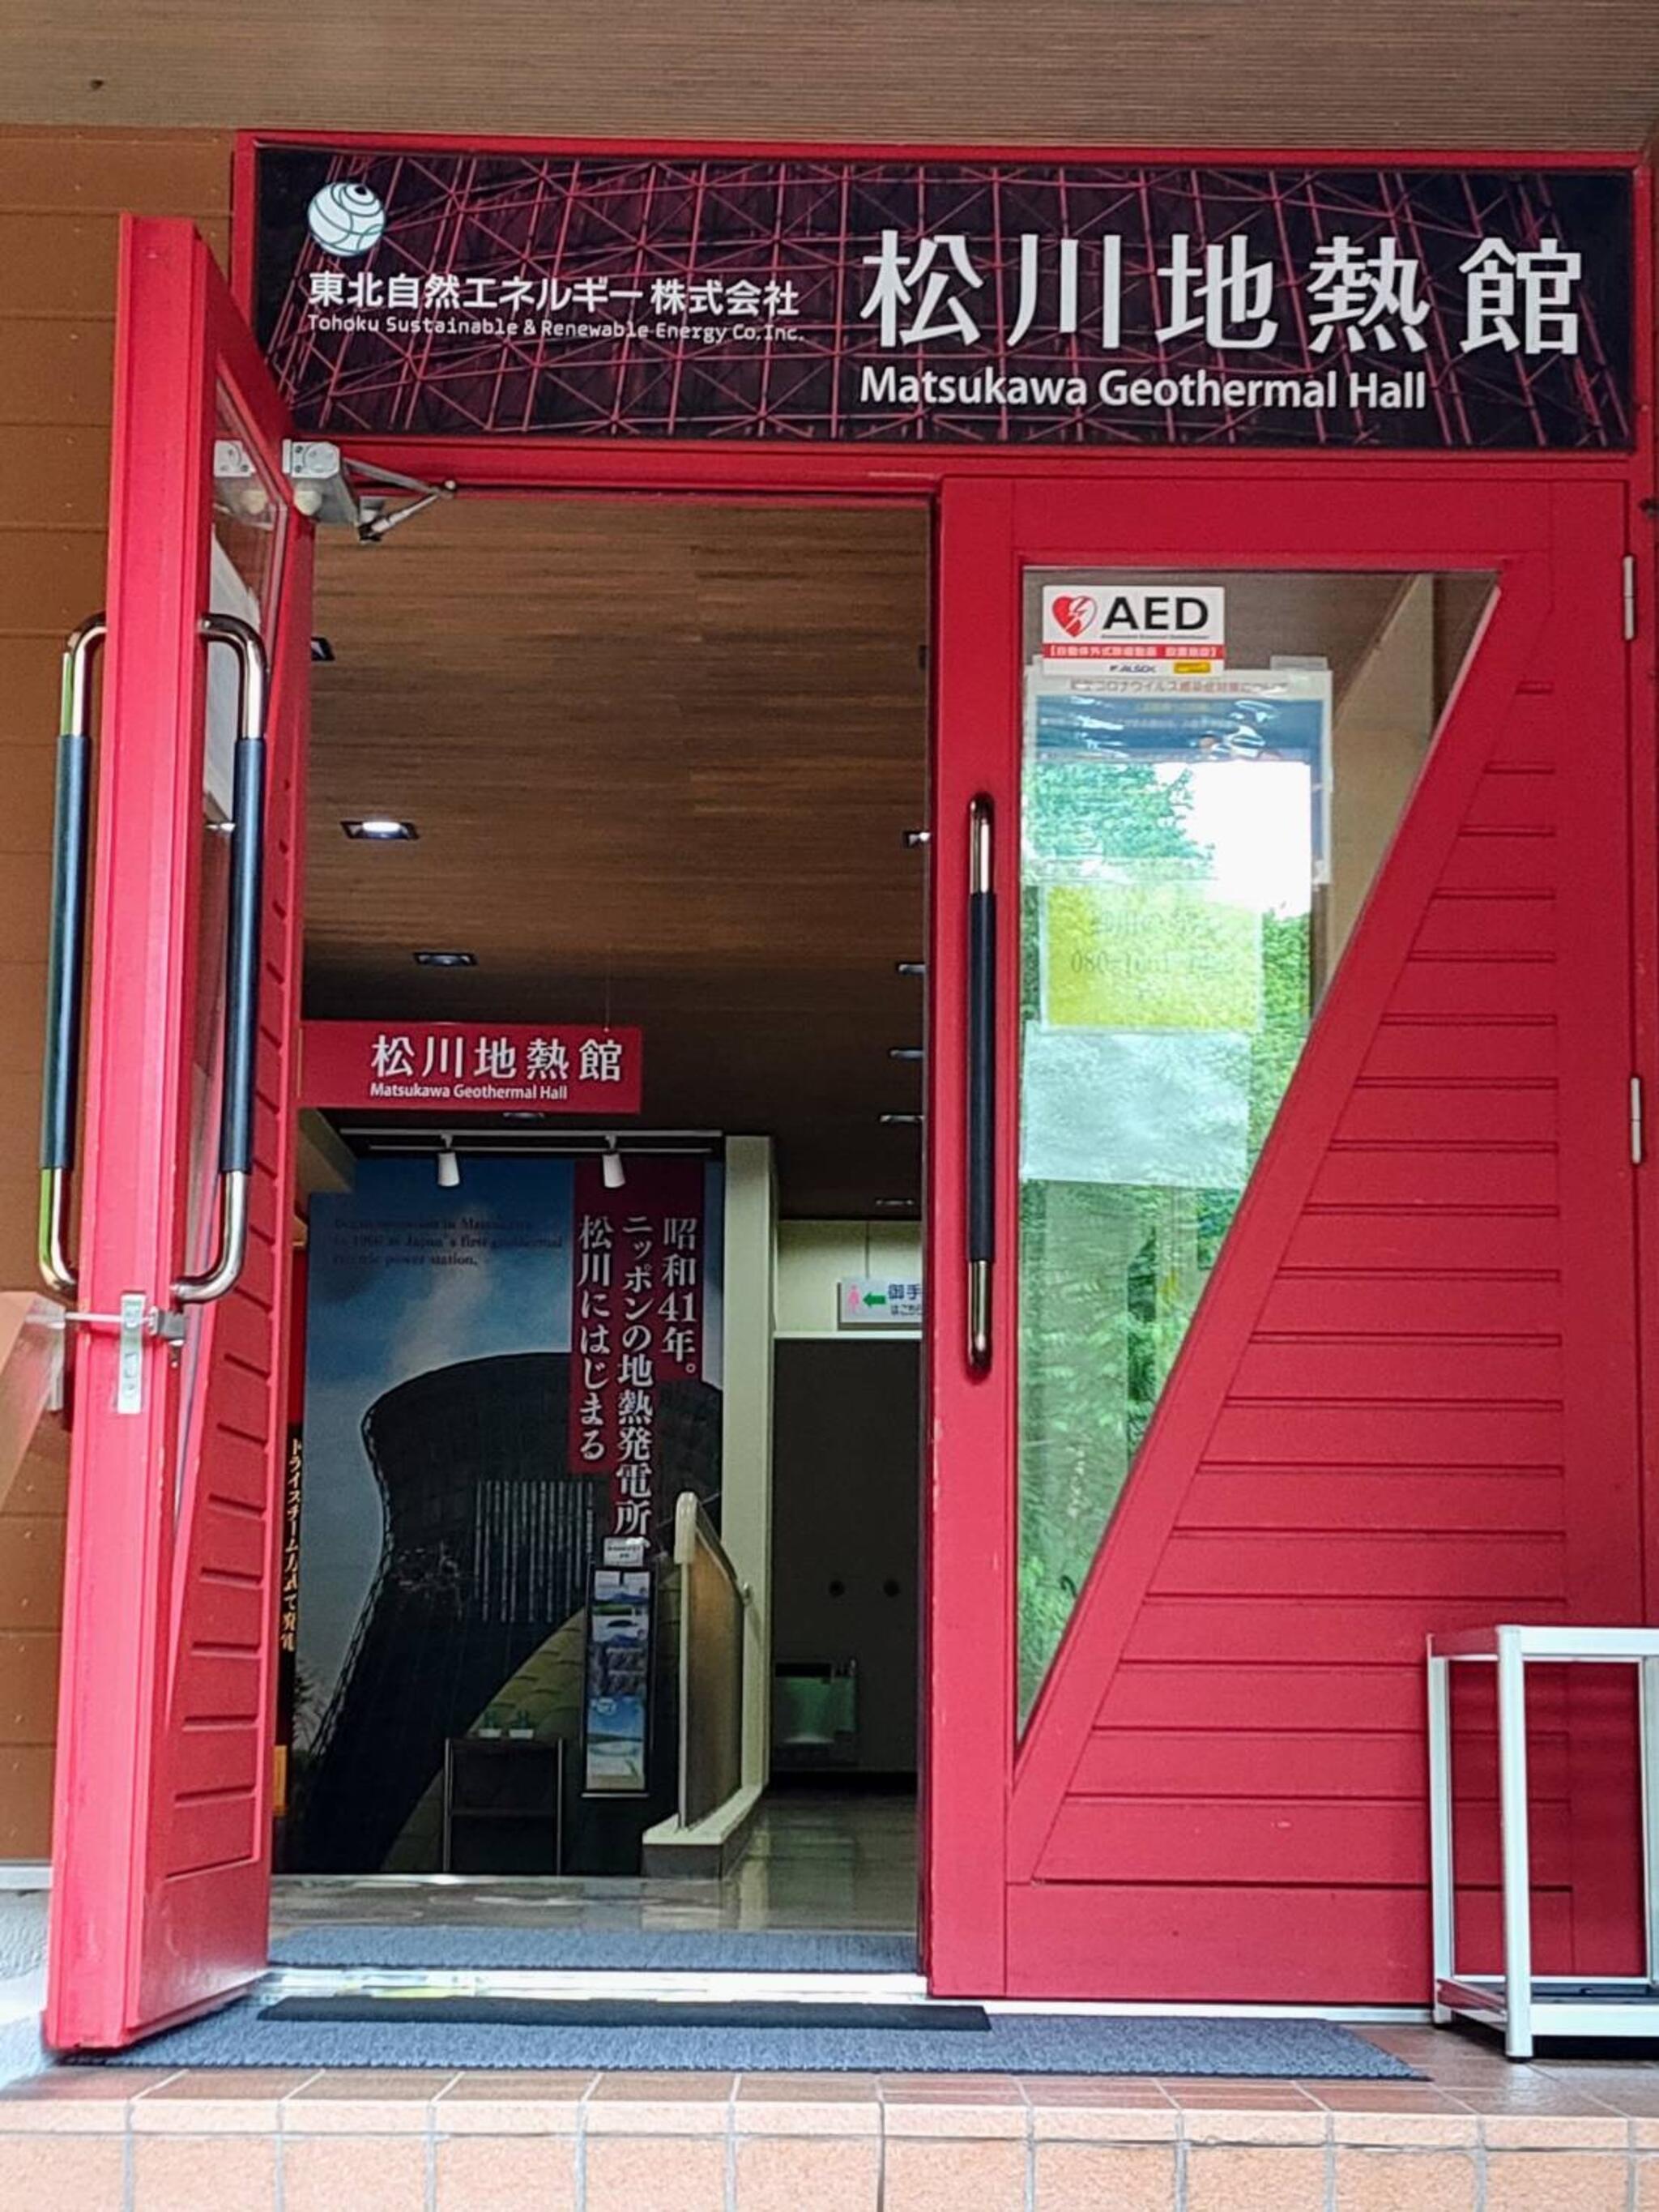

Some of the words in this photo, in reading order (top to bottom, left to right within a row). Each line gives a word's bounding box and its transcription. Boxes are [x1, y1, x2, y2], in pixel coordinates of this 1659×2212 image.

[308, 271, 644, 312] 東北自然エネルギー
[650, 279, 800, 316] 株式会社
[859, 228, 1584, 356] 松川地熱館
[308, 314, 380, 333] Tohoku
[386, 316, 518, 336] Sustainable
[523, 320, 536, 335] &
[541, 319, 649, 339] Renewable
[655, 322, 727, 344] Energy
[859, 366, 1088, 405] Matsukawa
[1098, 369, 1337, 408] Geothermal
[1348, 373, 1427, 409] Hall
[1102, 596, 1209, 630] AED
[370, 1035, 622, 1083] 松川地熱館
[370, 1083, 450, 1098] Matsukawa
[453, 1084, 537, 1100] Geothermal
[540, 1085, 568, 1100] Hall
[657, 1217, 697, 1374] 昭和41年。
[577, 1215, 615, 1460] 松川にはじまる
